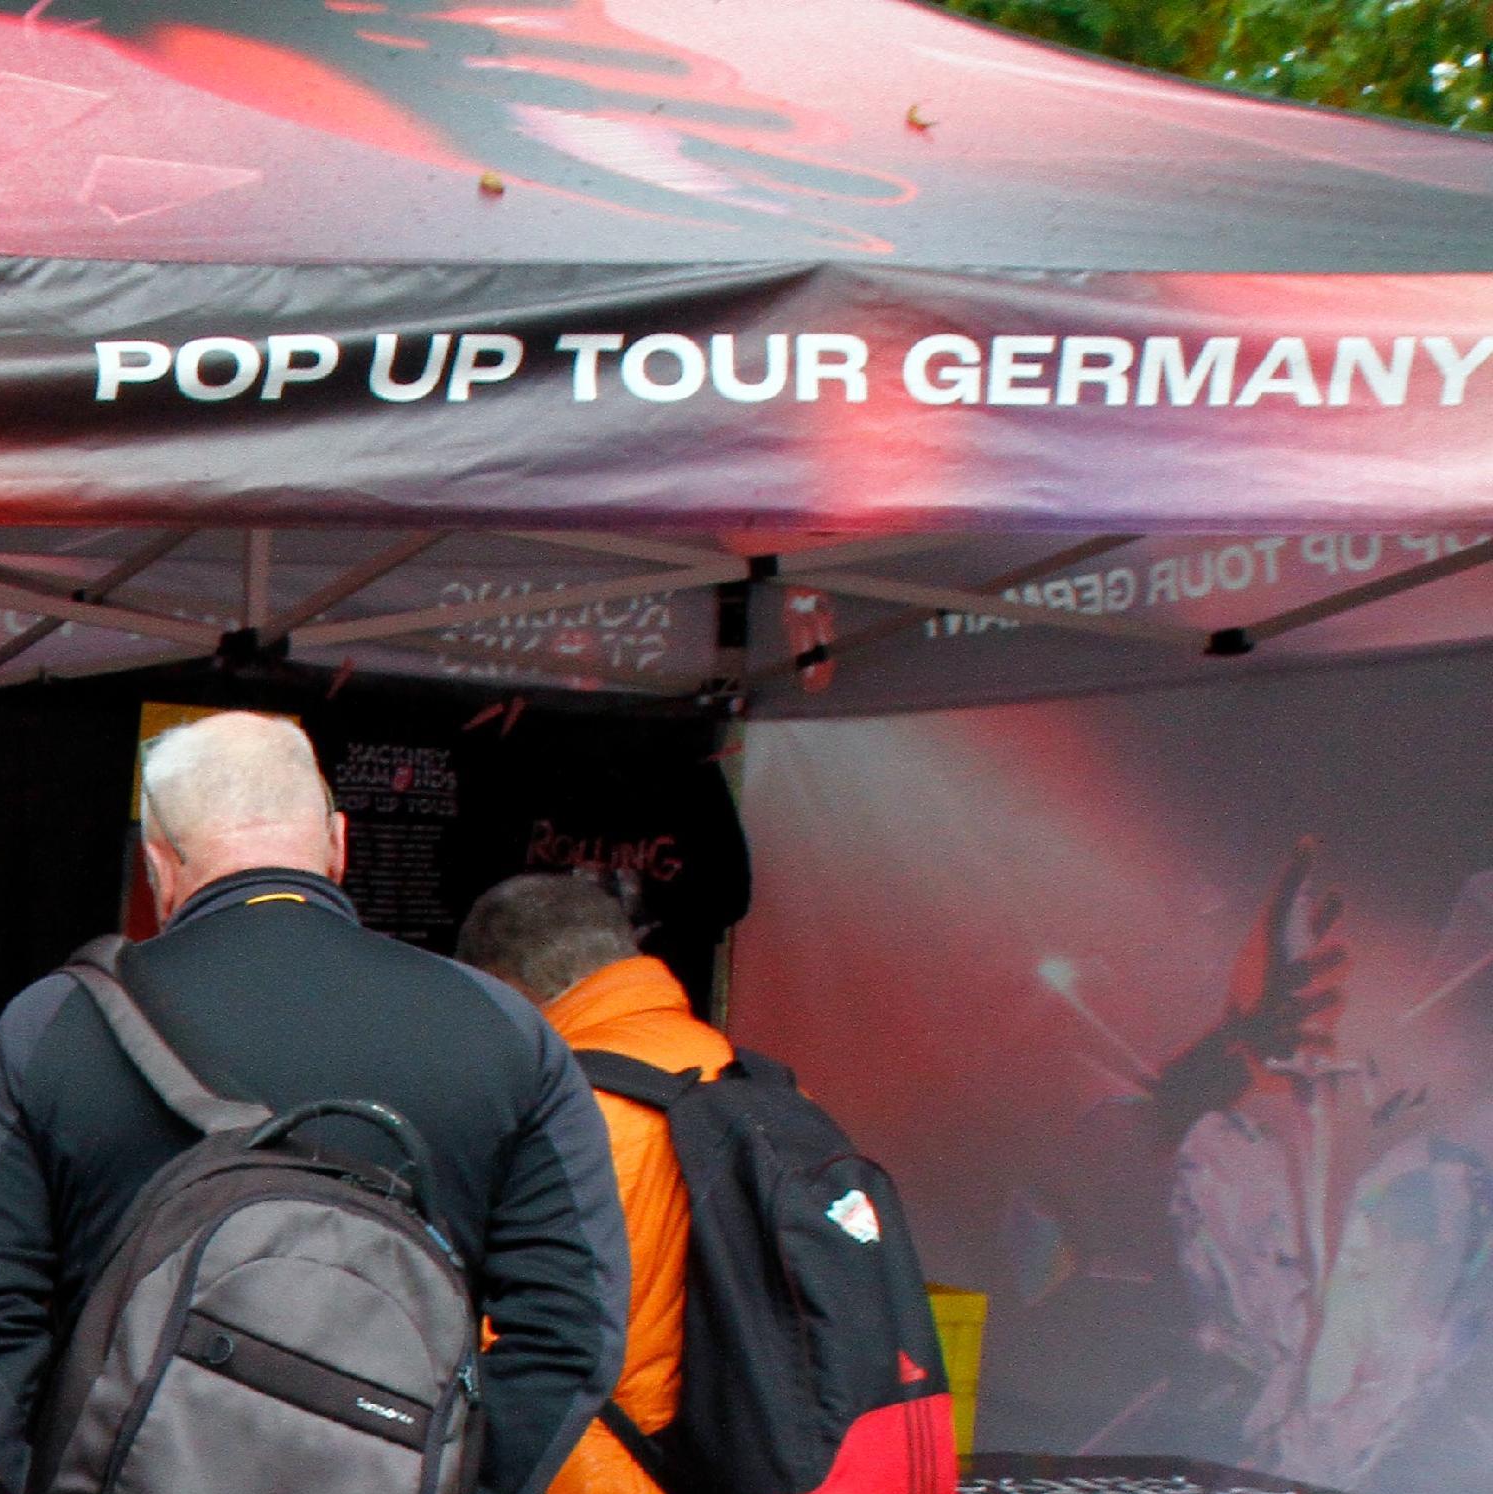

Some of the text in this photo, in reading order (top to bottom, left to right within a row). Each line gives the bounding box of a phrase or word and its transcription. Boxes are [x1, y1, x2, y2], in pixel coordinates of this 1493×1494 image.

[95, 333, 1493, 407] POP UP TOUR GERMANY
[525, 819, 684, 882] ROLLING
